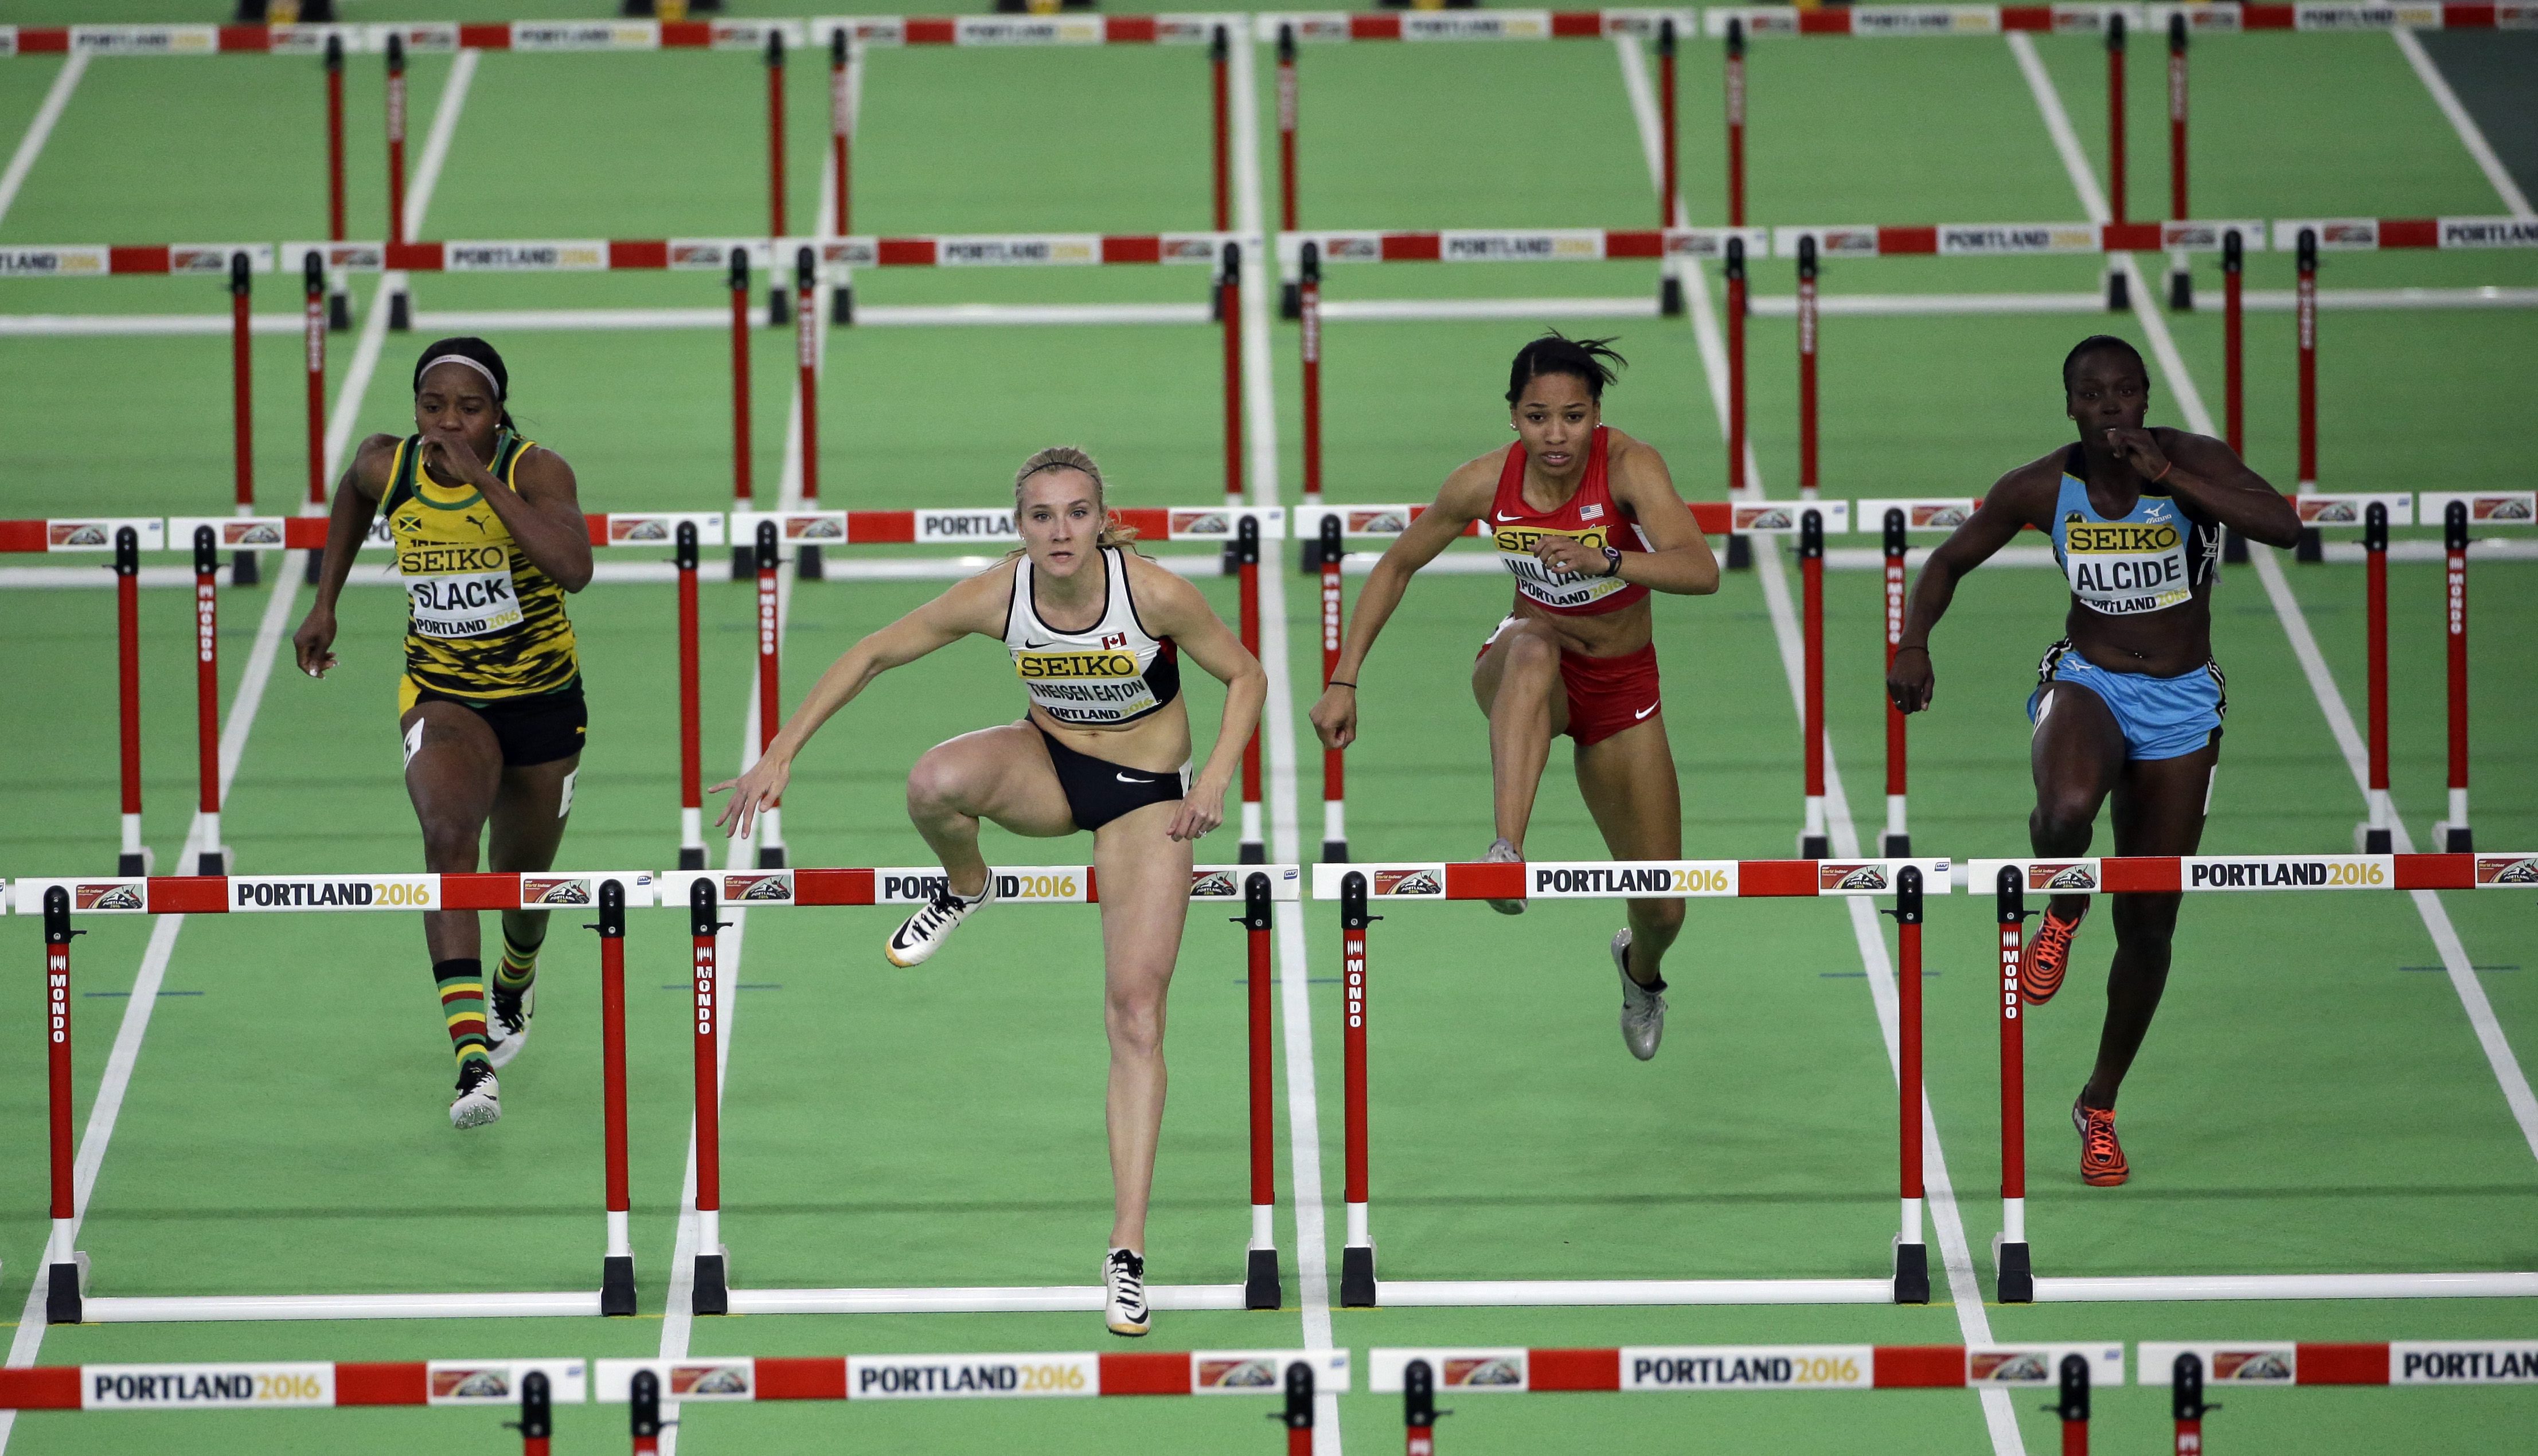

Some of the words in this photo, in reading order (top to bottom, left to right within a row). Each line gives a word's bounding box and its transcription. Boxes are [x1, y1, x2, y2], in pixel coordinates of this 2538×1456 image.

[926, 516, 1018, 535] PORTLA
[2070, 527, 2176, 551] SEIKO
[1497, 532, 1603, 552] SEO
[401, 546, 504, 573] SEIKO
[2077, 555, 2181, 591] ALCIDE
[413, 578, 510, 611] SLACK
[1021, 654, 1134, 677] SEIKO
[1026, 681, 1095, 701] THEISEN
[1091, 680, 1146, 702] EATON
[1347, 959, 1363, 1028] MONDO
[2002, 950, 2019, 1019] MONDO
[50, 974, 67, 1043] MONDO
[696, 966, 713, 1035] MONDO
[2404, 1351, 2538, 1379] PORTLAN
